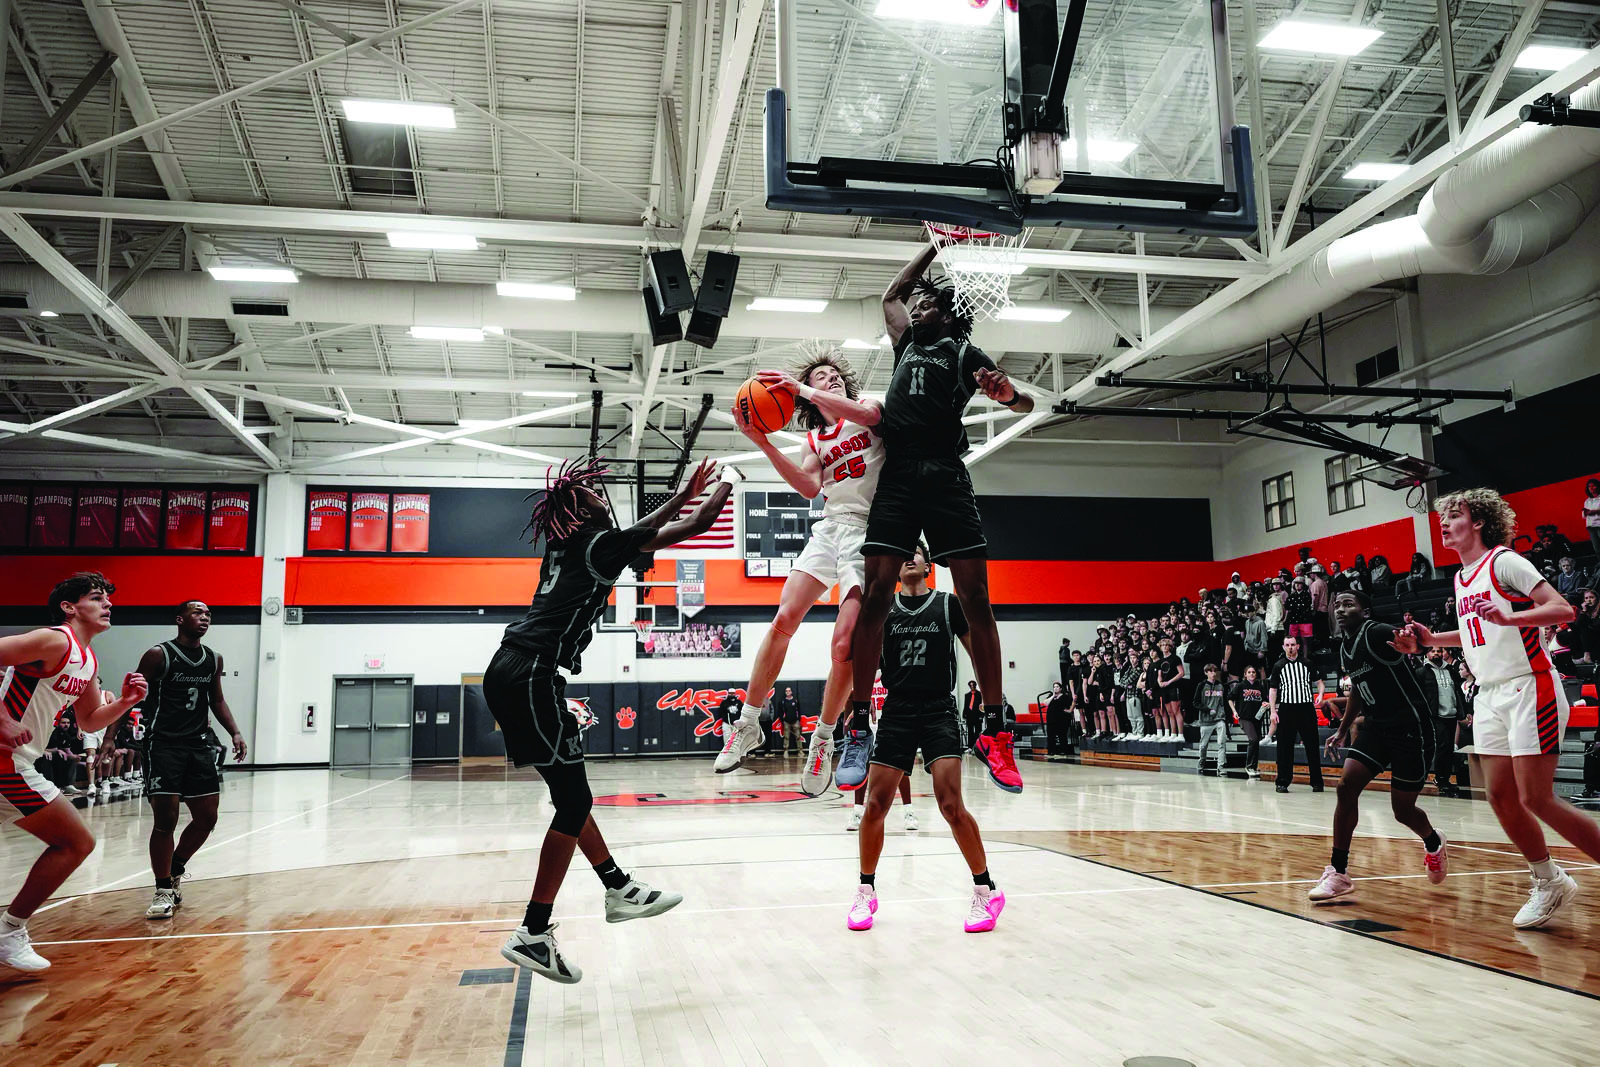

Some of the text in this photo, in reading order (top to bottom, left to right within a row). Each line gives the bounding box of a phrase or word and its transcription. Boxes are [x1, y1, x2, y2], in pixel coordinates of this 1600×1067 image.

[909, 366, 926, 395] 11
[823, 430, 873, 470] ARSON
[34, 495, 73, 507] CHAMPIONS
[79, 495, 117, 508] CHAMPIONS
[123, 496, 161, 508] CHAMPIONS
[168, 496, 206, 511] CHAMPIONS
[211, 498, 249, 512] CHAMPIONS
[310, 498, 347, 511] CHAMPIONS
[352, 499, 388, 513] CHAMPIONS
[393, 500, 429, 514] CHAMPIONS
[748, 509, 769, 518] HOME
[808, 510, 825, 519] GUE
[540, 549, 566, 595] 5
[889, 621, 941, 636] Kannapolis
[1466, 616, 1486, 648] 11
[900, 638, 927, 667] 22
[185, 687, 199, 711] 3
[565, 734, 582, 757] K
[149, 776, 162, 791] K
